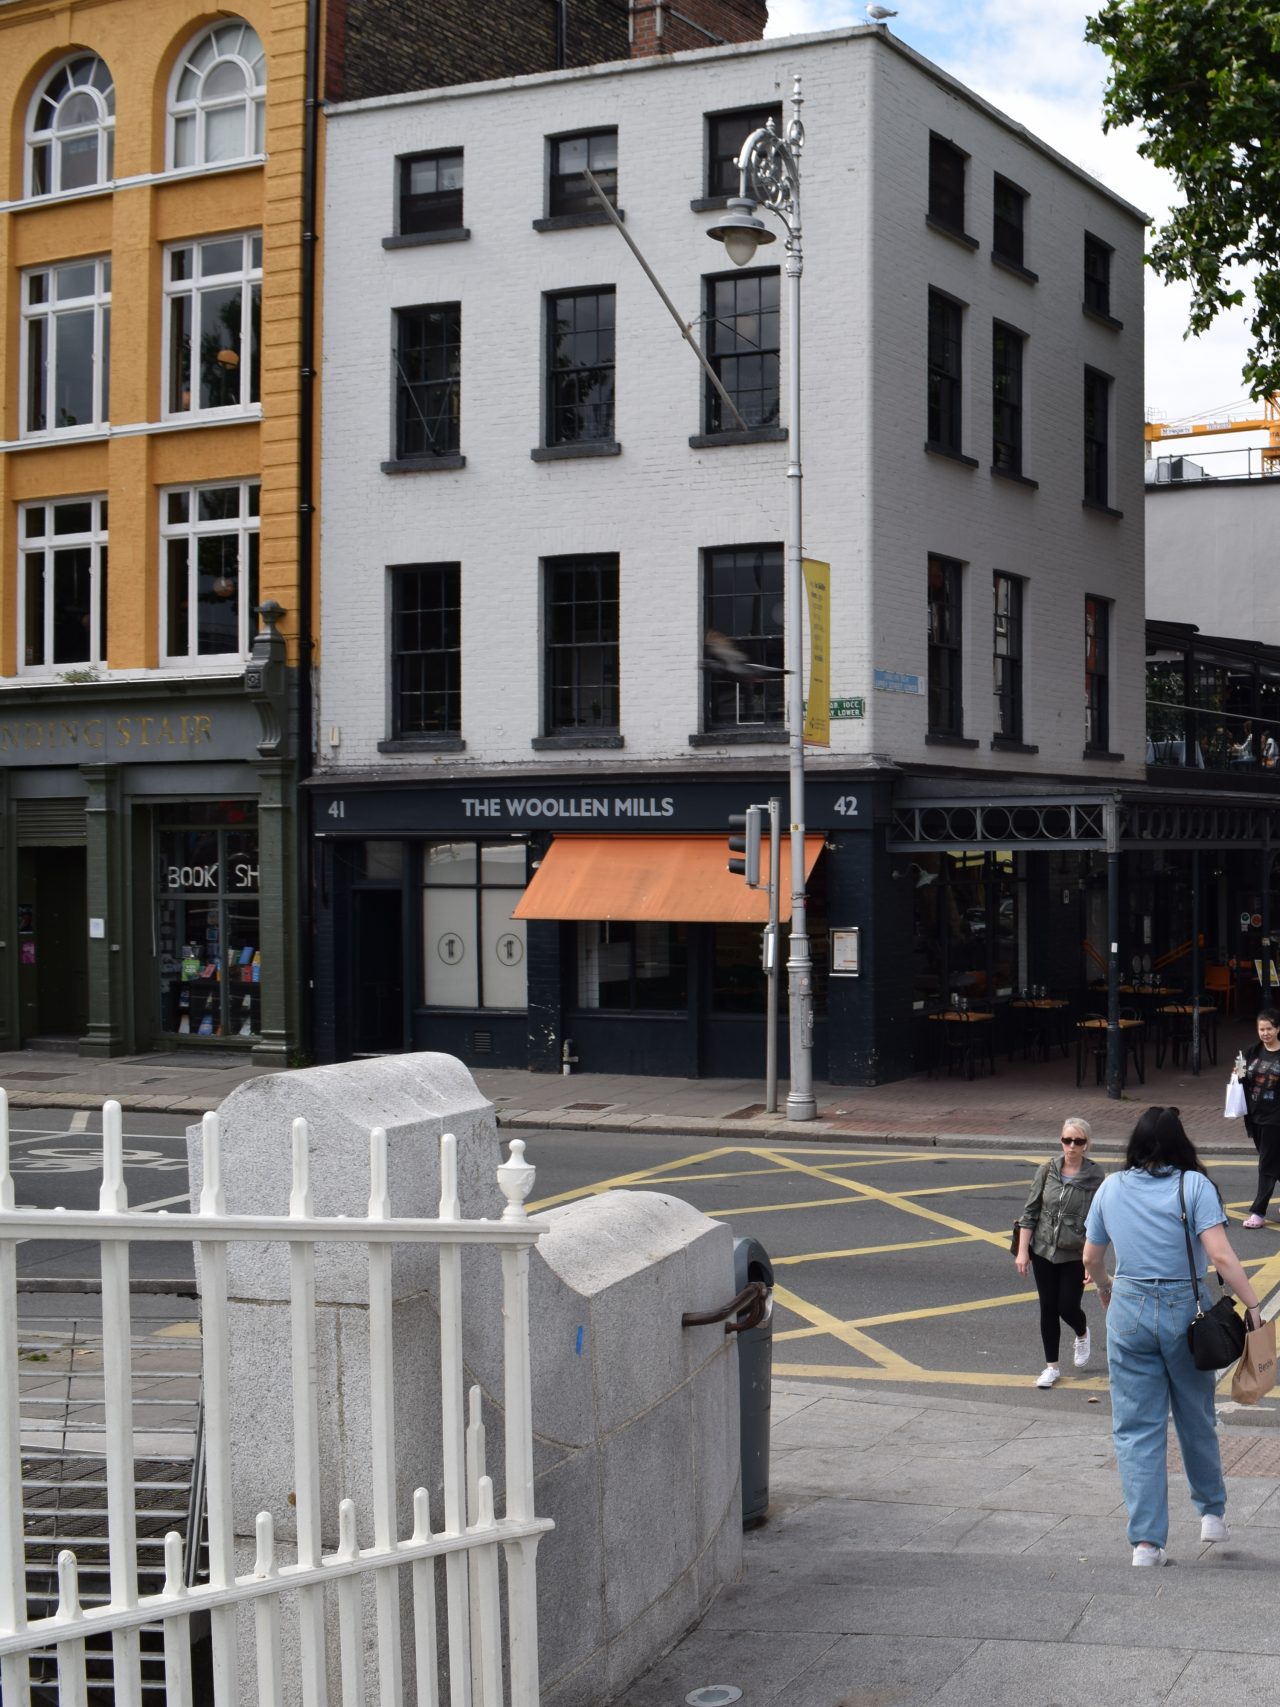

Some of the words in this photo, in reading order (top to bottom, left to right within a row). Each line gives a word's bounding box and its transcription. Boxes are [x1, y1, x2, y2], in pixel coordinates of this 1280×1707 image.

[116, 713, 214, 746] STAIR
[327, 804, 345, 818] 41
[462, 798, 501, 817] THE
[505, 798, 609, 817] WOOLLEN
[614, 797, 674, 817] MILLS
[834, 795, 859, 816] 42
[168, 862, 219, 888] BOOK
